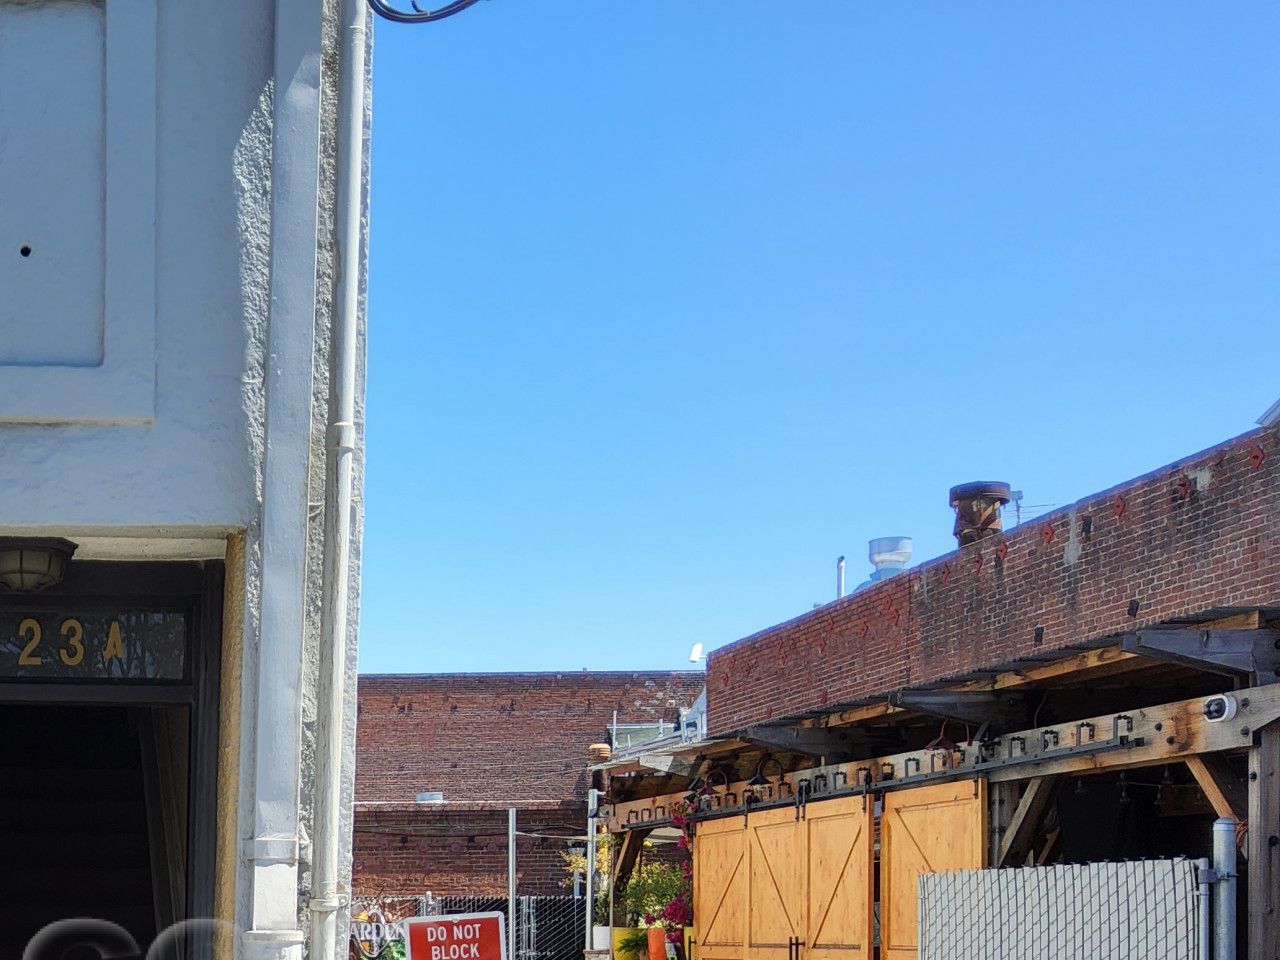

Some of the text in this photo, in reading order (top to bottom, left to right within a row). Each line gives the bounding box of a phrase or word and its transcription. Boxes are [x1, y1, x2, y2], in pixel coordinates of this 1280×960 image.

[427, 924, 482, 942] DO NOT
[431, 943, 480, 960] BLOCK
